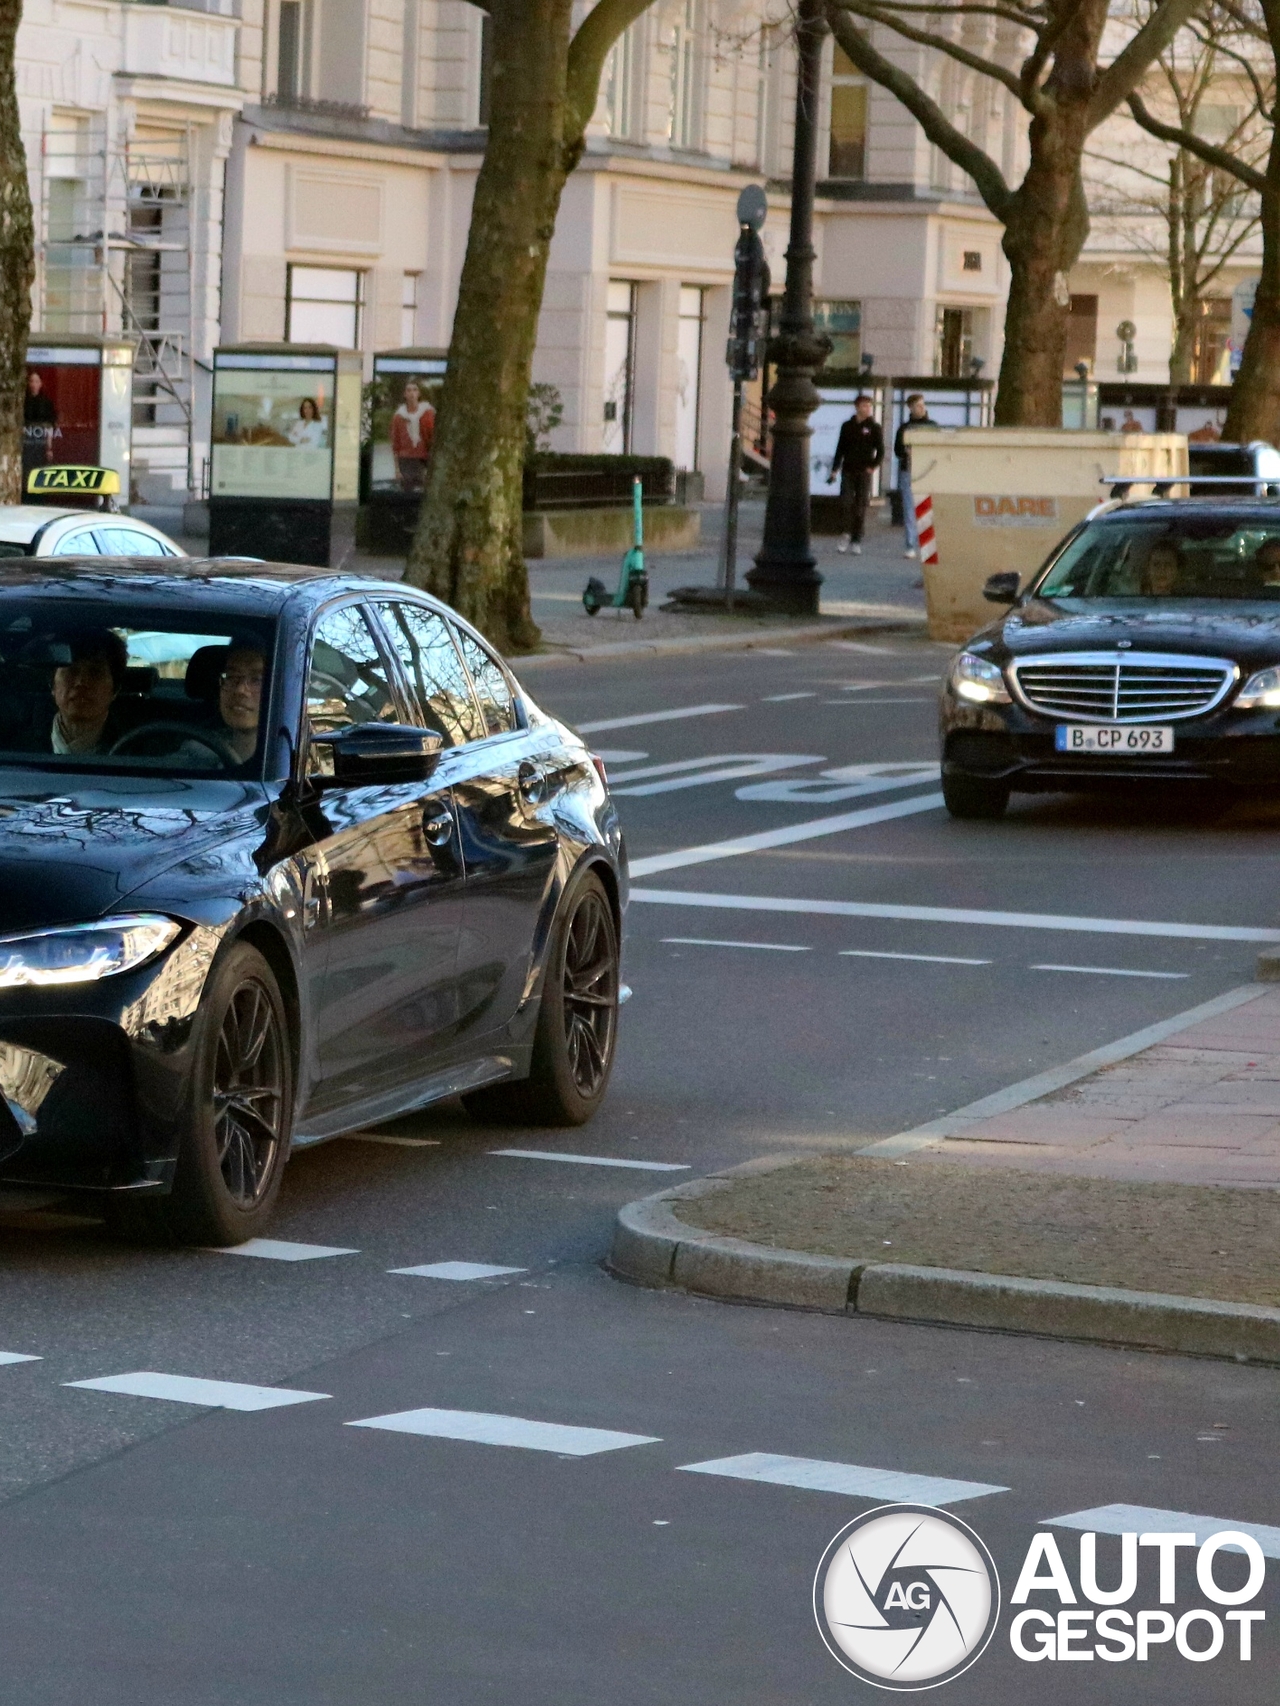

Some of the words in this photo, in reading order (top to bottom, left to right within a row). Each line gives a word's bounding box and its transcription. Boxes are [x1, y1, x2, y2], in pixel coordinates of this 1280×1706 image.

[43, 471, 98, 487] TAXI
[975, 497, 1055, 517] DARE
[1073, 730, 1084, 747] B
[1097, 730, 1122, 748] CP
[1127, 731, 1163, 748] 693
